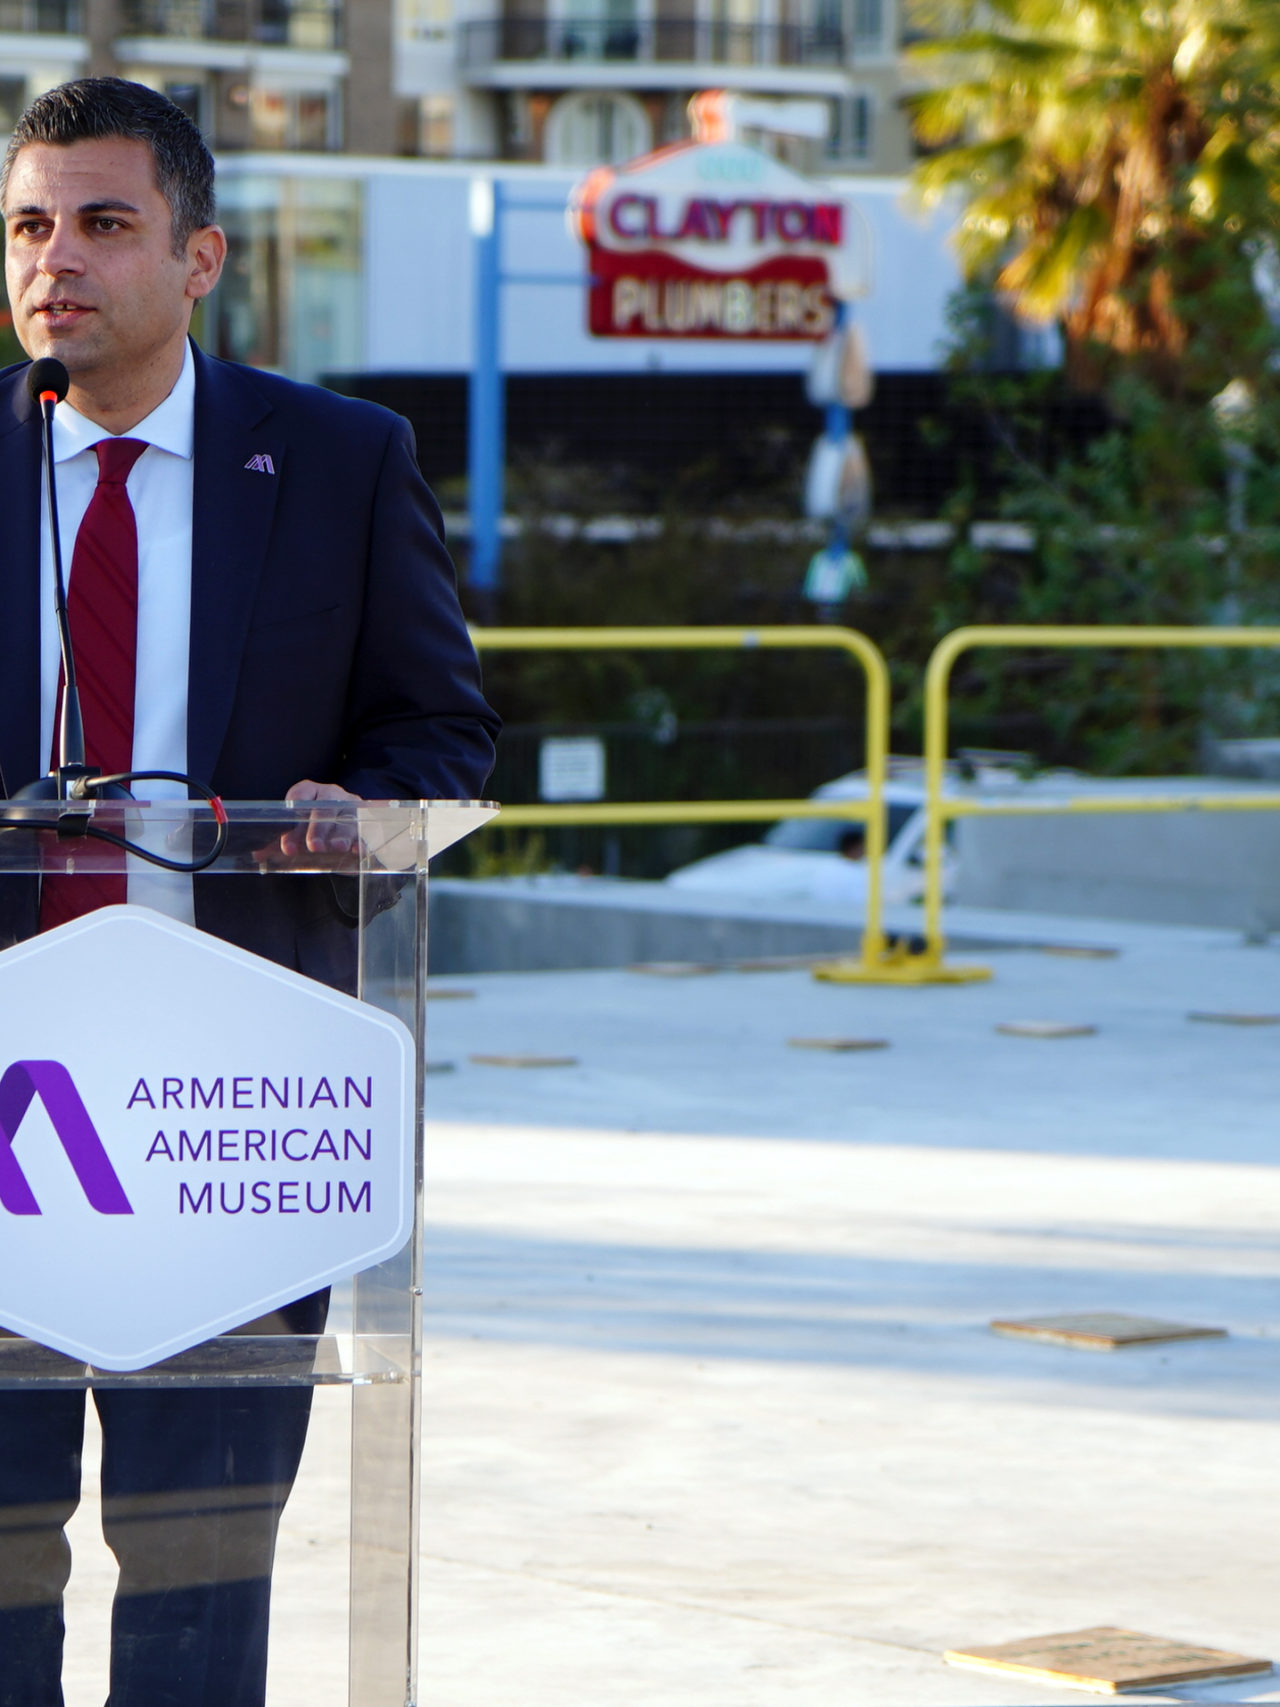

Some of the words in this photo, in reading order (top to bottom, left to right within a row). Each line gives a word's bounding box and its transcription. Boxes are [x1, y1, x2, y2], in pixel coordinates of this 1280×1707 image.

[609, 194, 845, 245] CLAYTON
[612, 276, 832, 336] PLUMBERS
[126, 1076, 373, 1110] ARMENIAN
[145, 1128, 372, 1162] AMERICAN
[178, 1180, 372, 1215] MUSEUM
